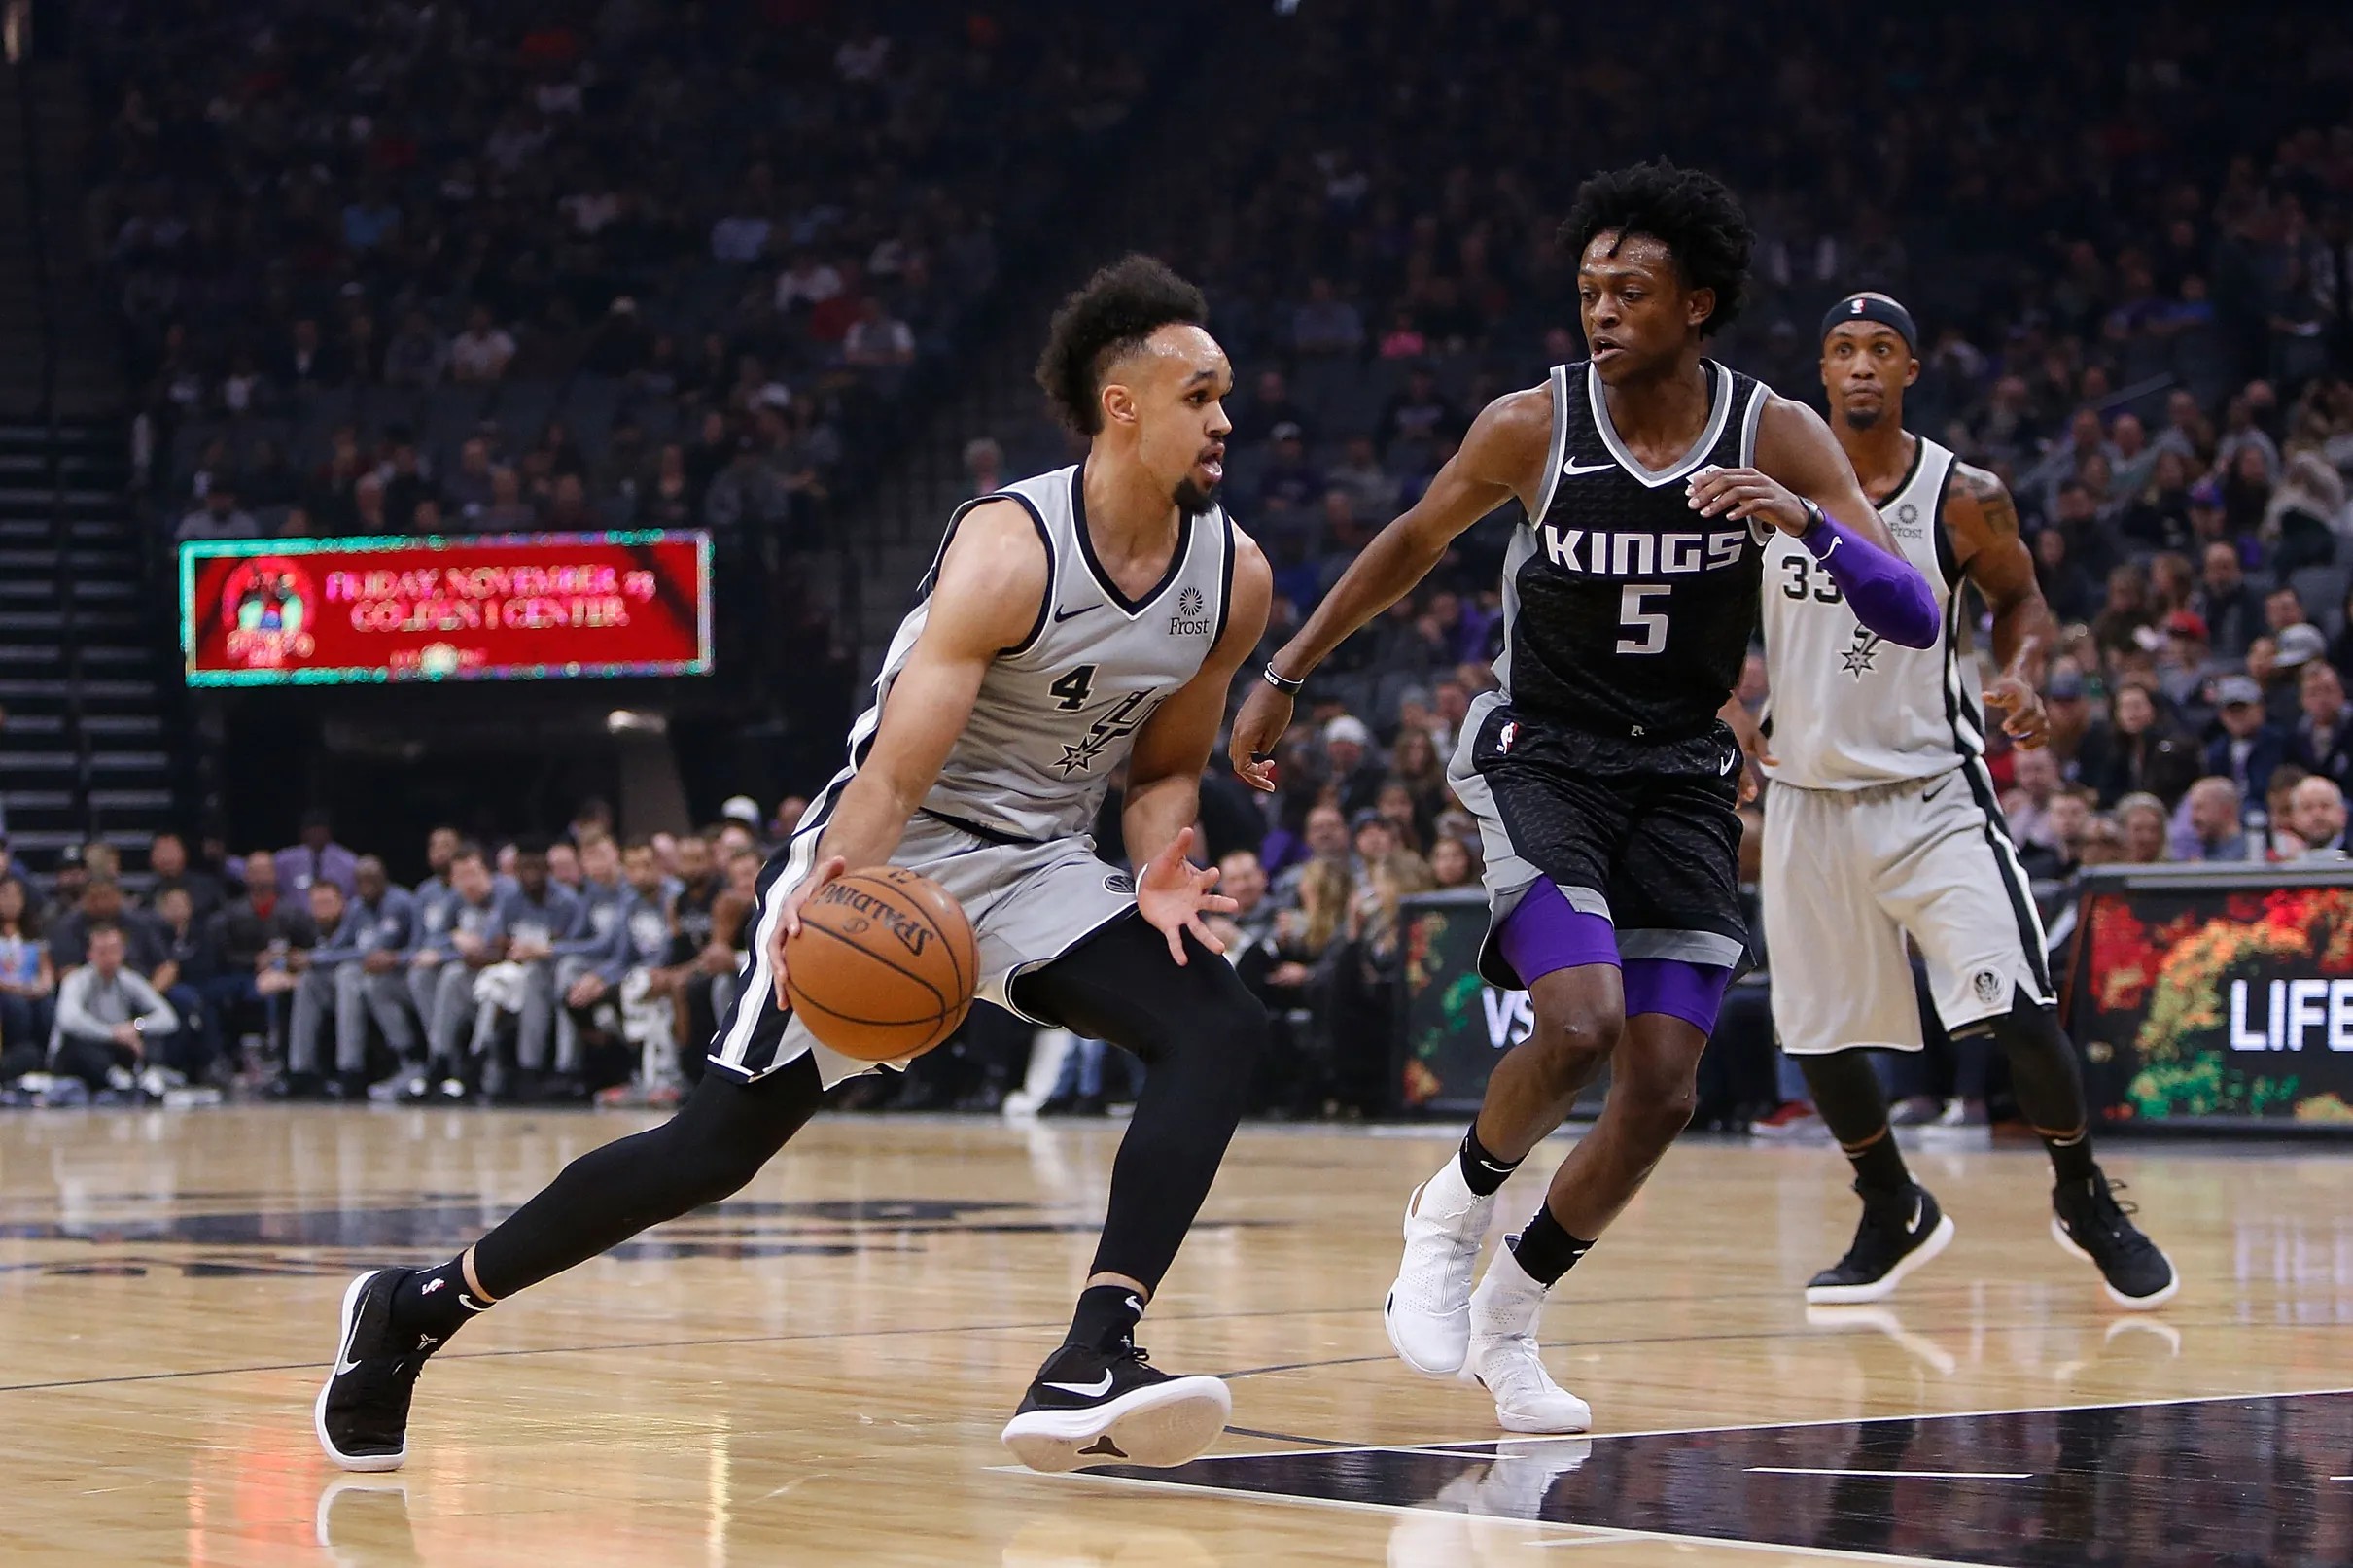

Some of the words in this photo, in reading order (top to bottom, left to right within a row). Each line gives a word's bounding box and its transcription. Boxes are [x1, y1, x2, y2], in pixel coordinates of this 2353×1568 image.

[1544, 523, 1746, 574] KINGS
[1169, 617, 1209, 635] Frost
[1615, 584, 1671, 654] 5
[1047, 664, 1099, 712] 4
